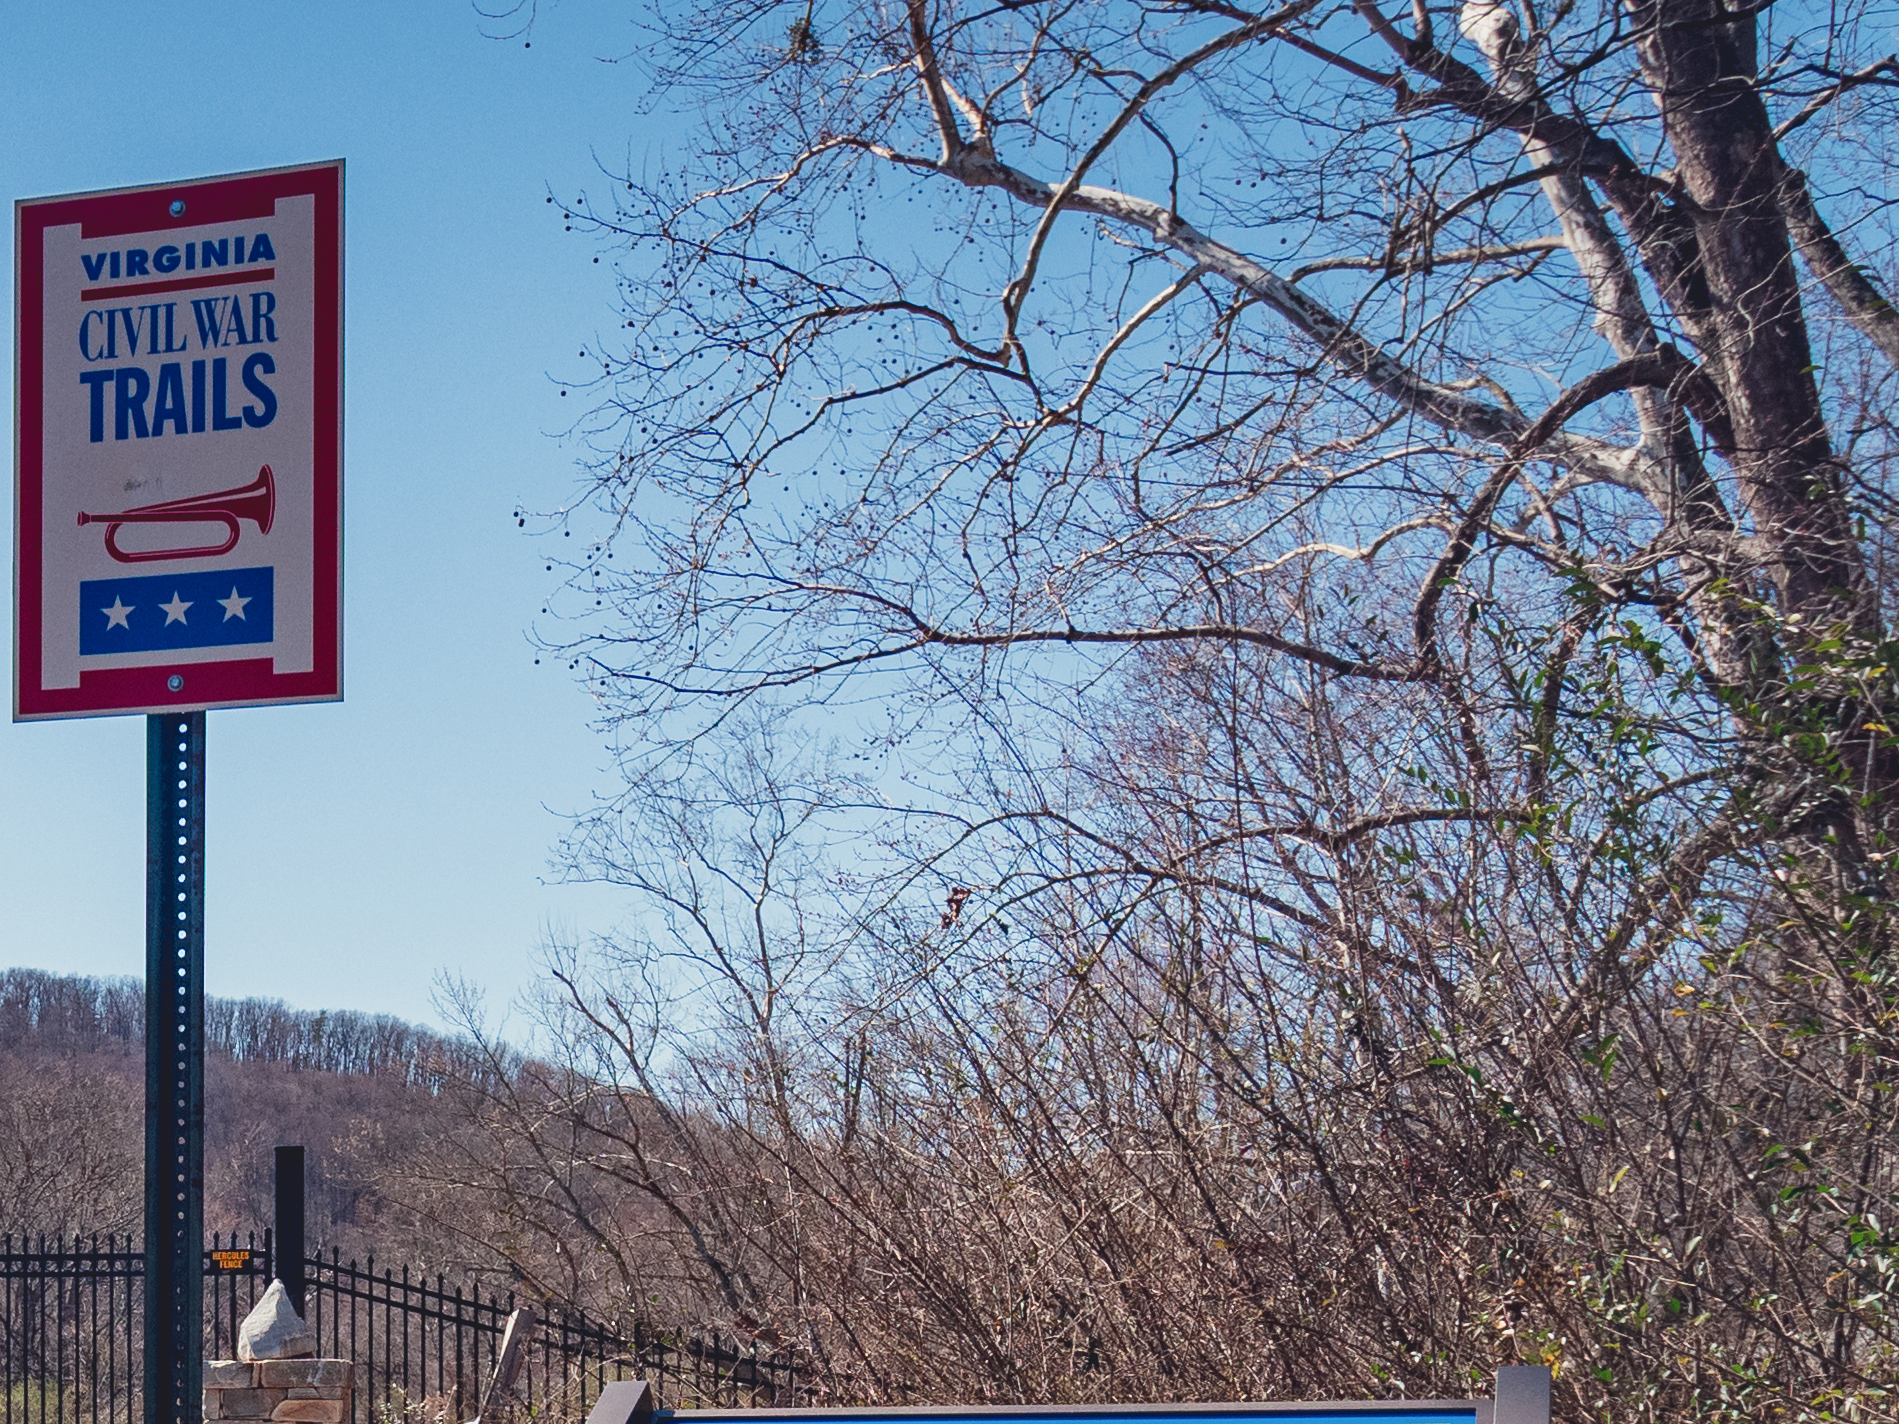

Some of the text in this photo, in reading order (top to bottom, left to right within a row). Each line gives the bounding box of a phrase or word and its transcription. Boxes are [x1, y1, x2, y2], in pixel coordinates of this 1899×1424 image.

[81, 233, 276, 281] VIRGINIA
[79, 291, 279, 362] CIVIL WAR
[79, 352, 278, 443] TRAILS
[212, 1251, 249, 1260] HERCULES
[219, 1259, 243, 1269] FENCE
